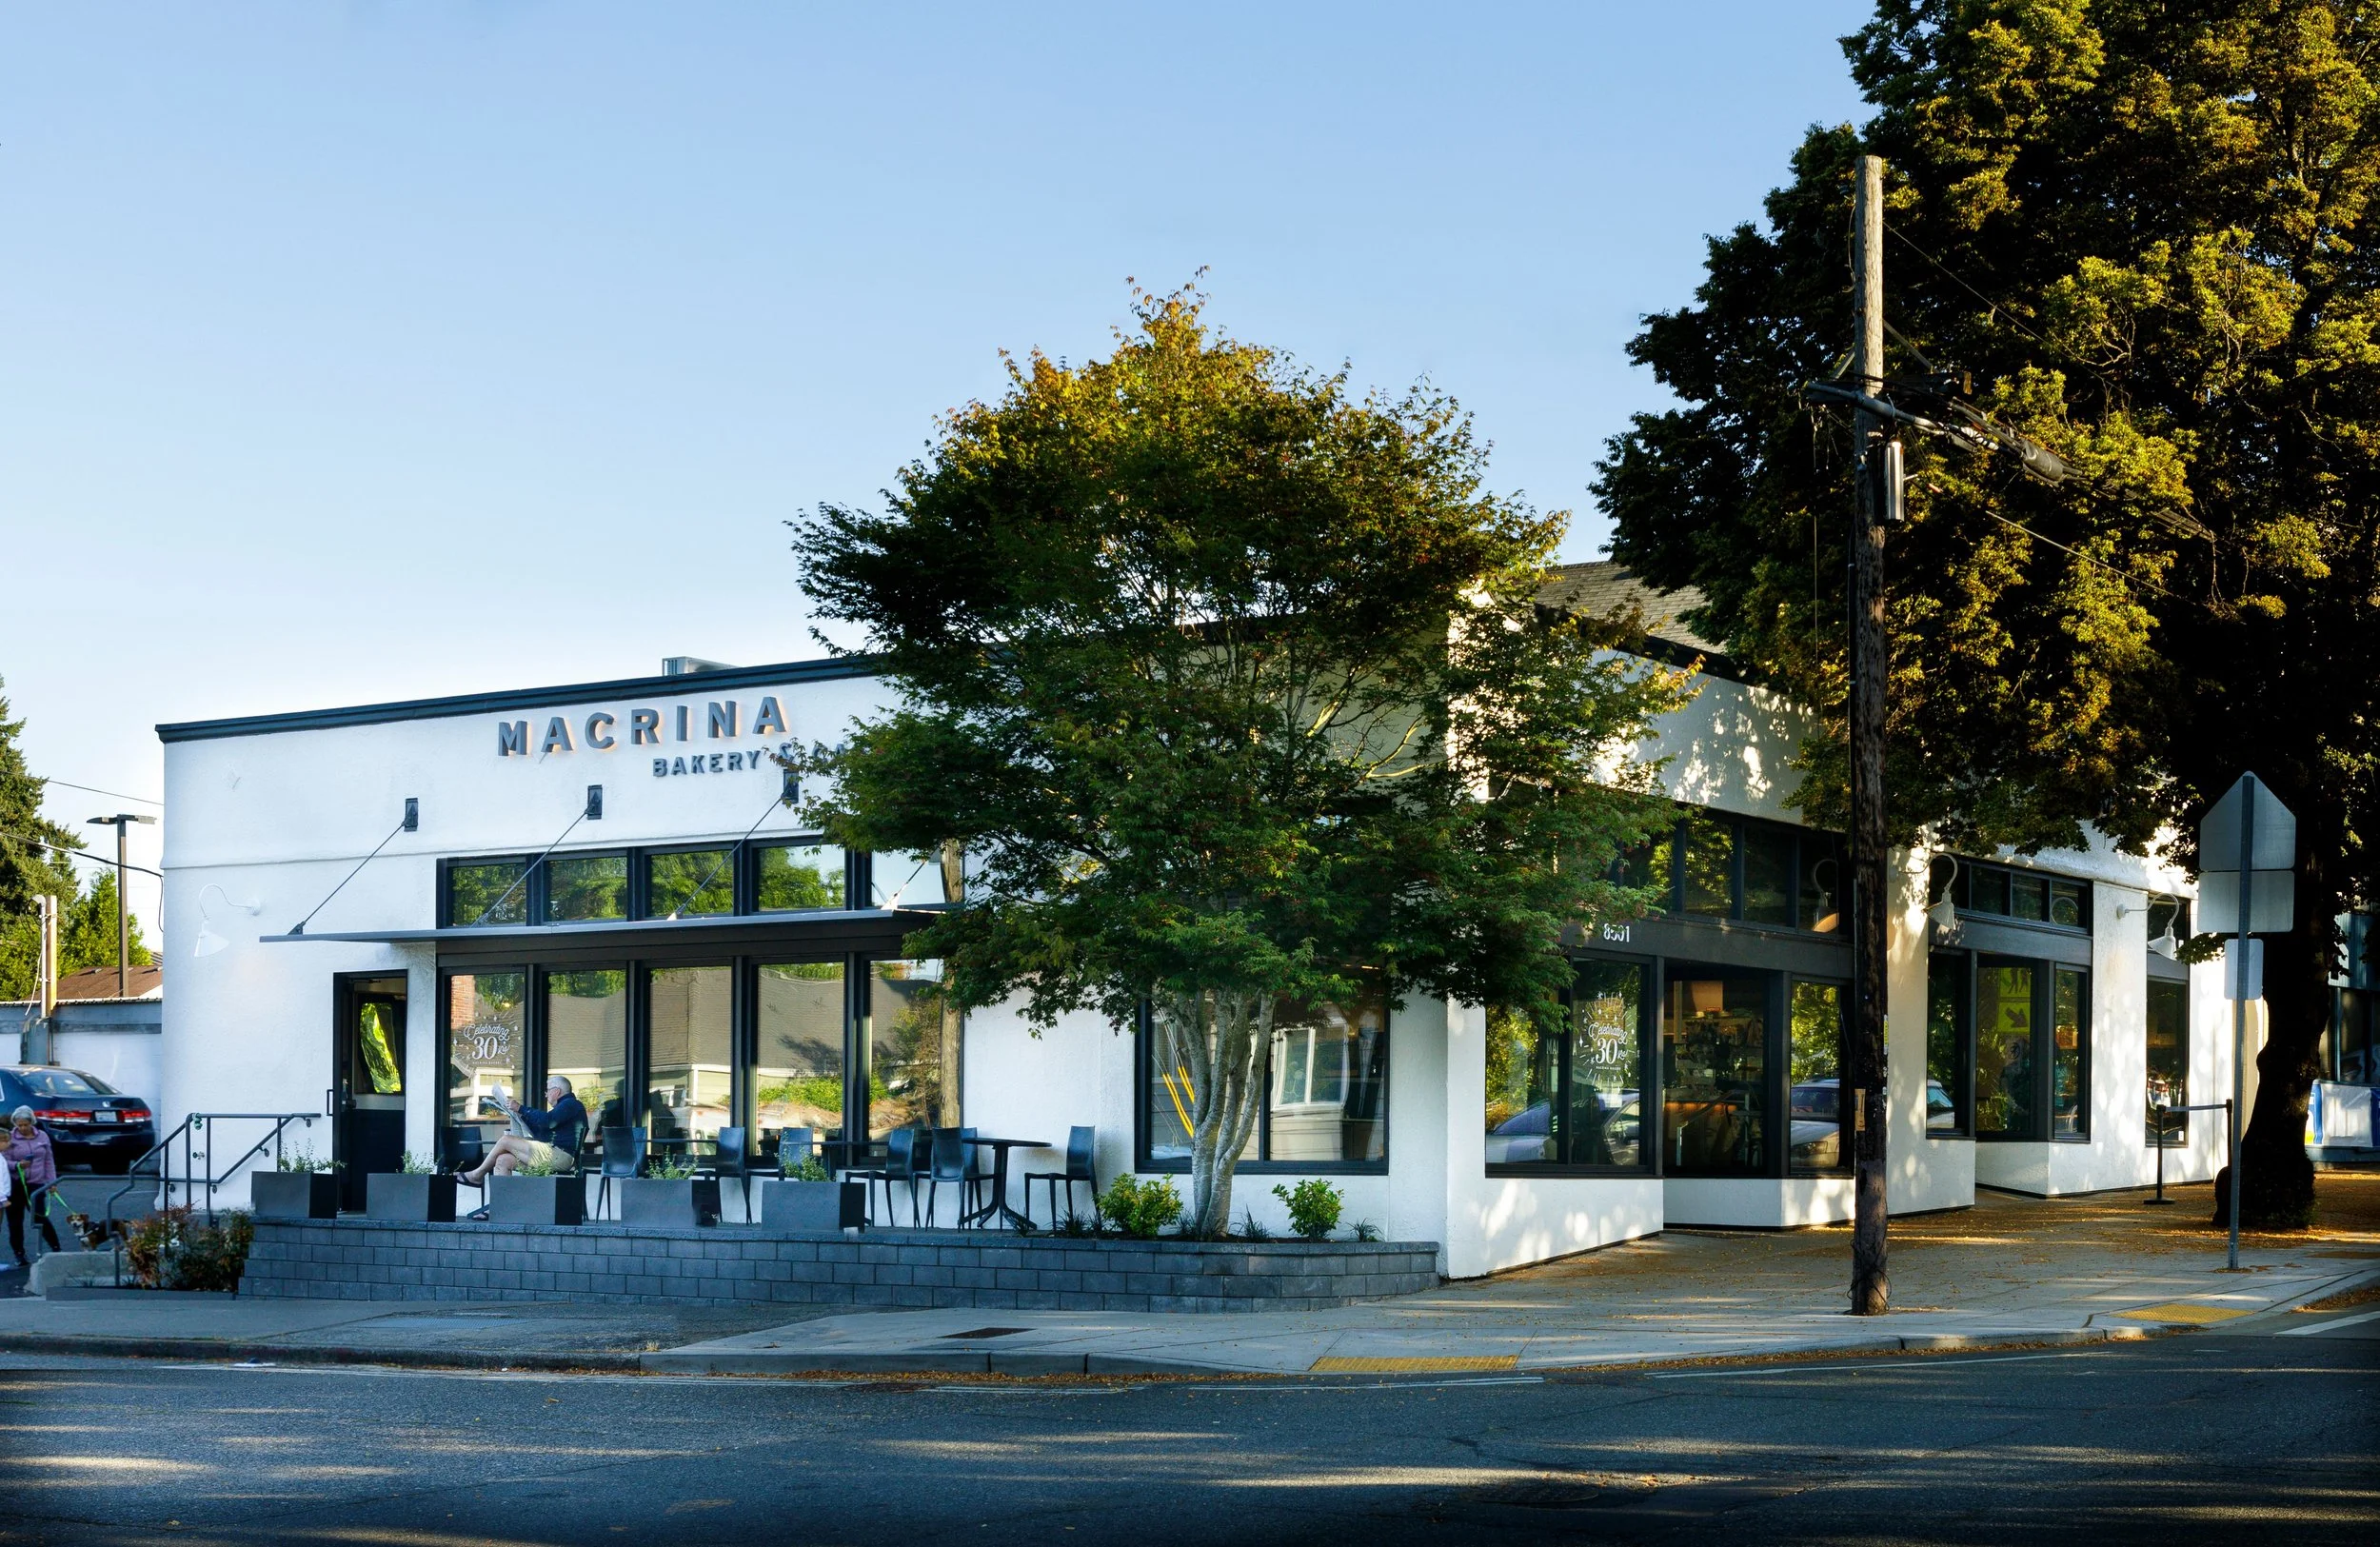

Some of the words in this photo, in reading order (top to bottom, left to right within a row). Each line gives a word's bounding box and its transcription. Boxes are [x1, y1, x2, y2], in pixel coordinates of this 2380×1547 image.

[498, 696, 787, 757] MACRINA
[653, 750, 761, 778] BAKERY
[1603, 922, 1630, 942] 8501
[464, 1023, 510, 1041] Celebrating
[1588, 1021, 1628, 1045] Celebrating
[472, 1036, 498, 1060] 30
[1596, 1038, 1617, 1064] 30
